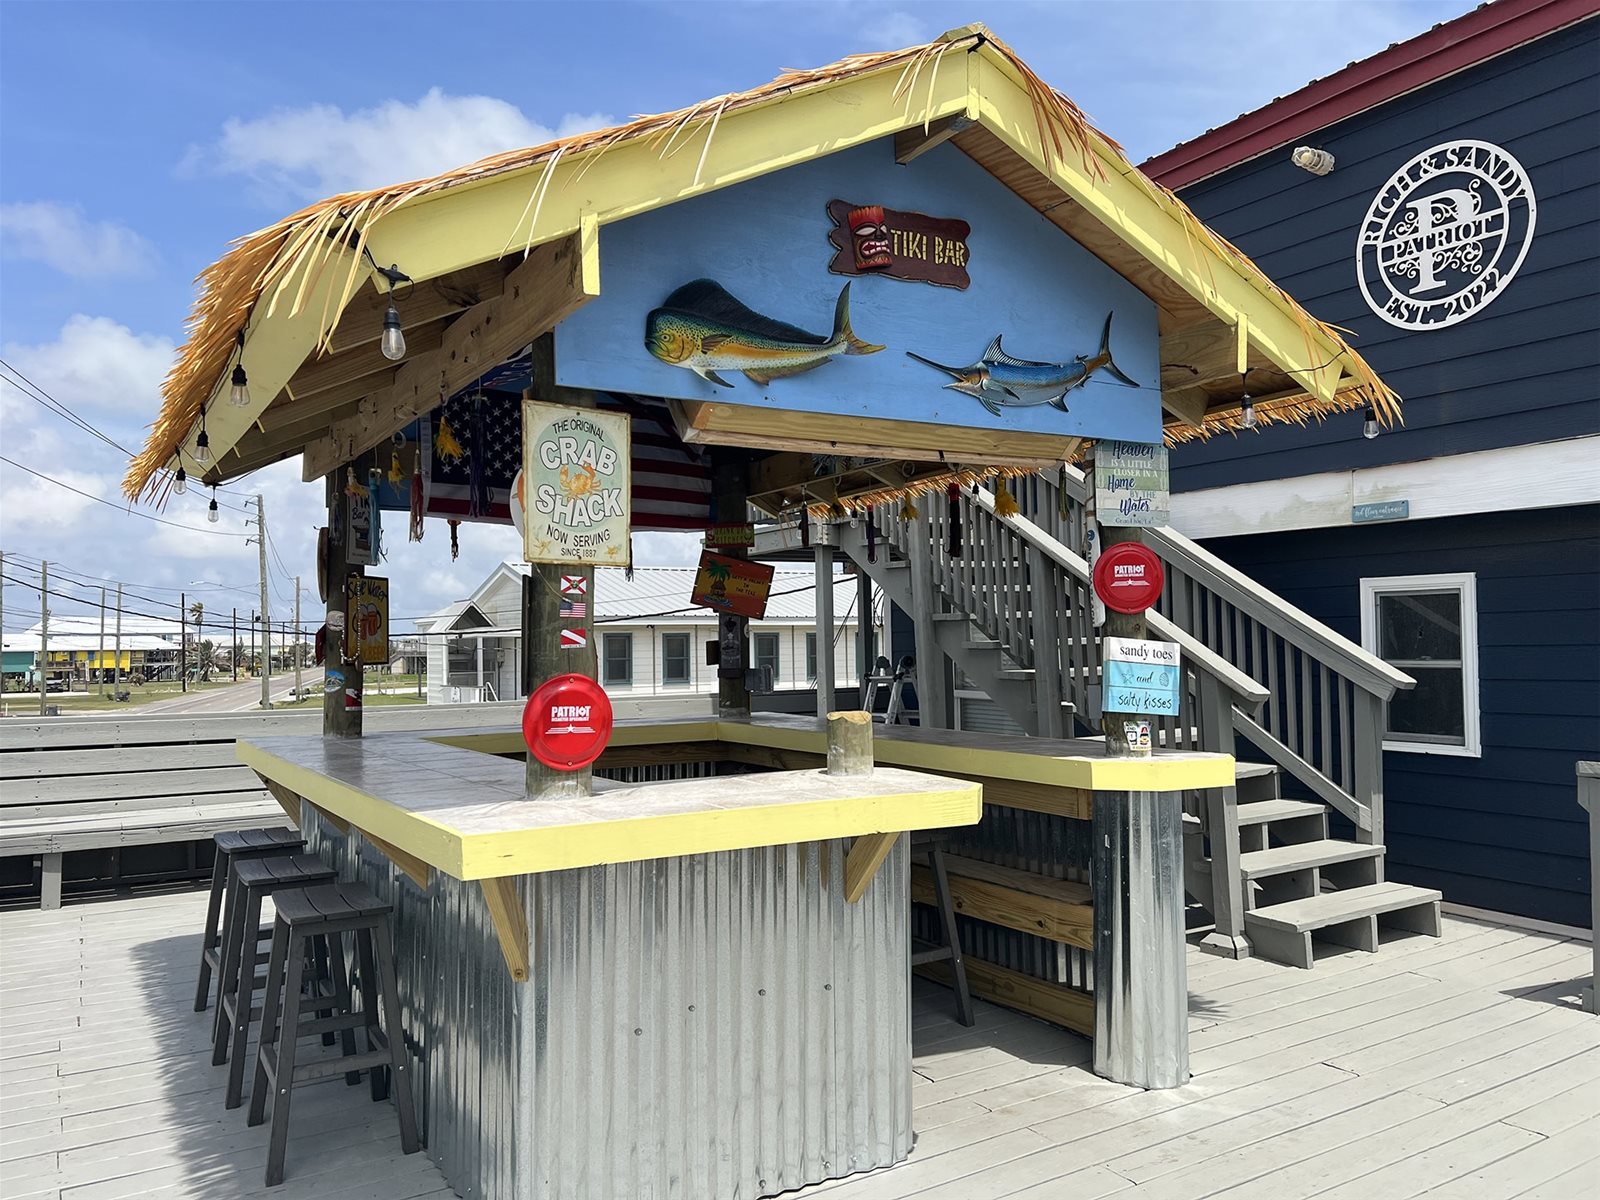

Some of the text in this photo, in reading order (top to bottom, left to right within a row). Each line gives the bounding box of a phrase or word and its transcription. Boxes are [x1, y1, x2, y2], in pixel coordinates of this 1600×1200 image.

[1364, 147, 1528, 243] RICH & SANDY
[890, 229, 966, 267] TIKI BAR
[1393, 218, 1491, 262] PATRIOT
[1382, 267, 1507, 325] EST. 2022
[552, 418, 605, 443] THE ORIGINAL
[539, 436, 618, 476] CRAB
[1112, 440, 1155, 460] Heaven
[1111, 459, 1153, 469] IS A LITTLE
[1113, 469, 1158, 478] CLOSER IN A
[1107, 475, 1135, 493] Home
[1142, 491, 1156, 499] THE
[535, 484, 624, 527] SHACK
[1119, 496, 1152, 516] Water
[547, 524, 611, 547] NOW SERVING
[560, 548, 580, 557] SINCE
[1114, 565, 1146, 575] PATRIOT
[1119, 643, 1173, 660] sandy toes
[1136, 671, 1154, 683] and
[551, 705, 592, 718] PATRIOT
[1118, 691, 1172, 712] salty kisses
